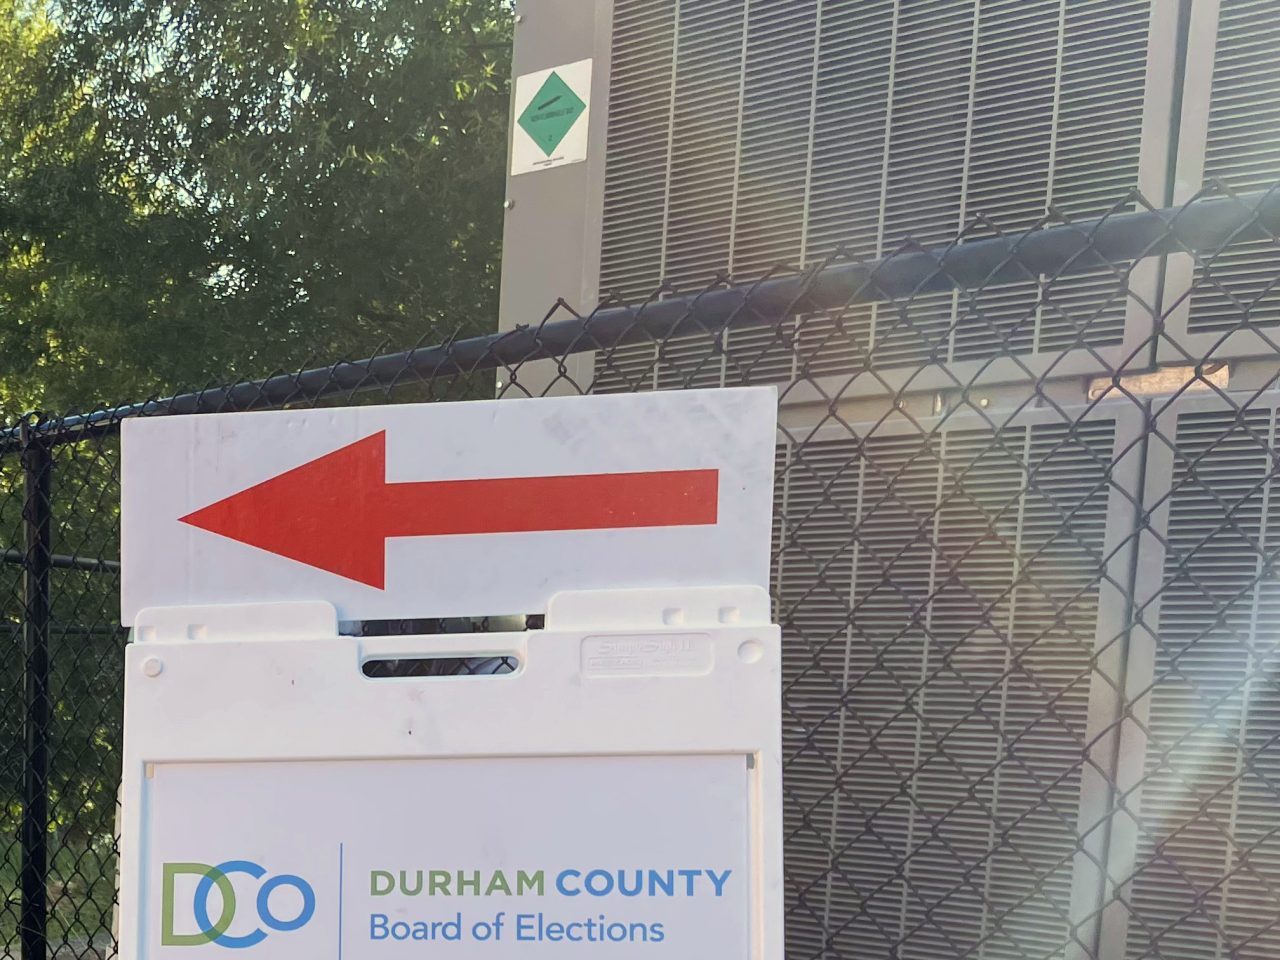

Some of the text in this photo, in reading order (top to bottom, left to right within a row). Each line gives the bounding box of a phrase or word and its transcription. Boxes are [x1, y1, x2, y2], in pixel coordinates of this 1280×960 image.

[370, 869, 733, 897] DURHAM COUNTY
[370, 912, 665, 942] Board of Elections
